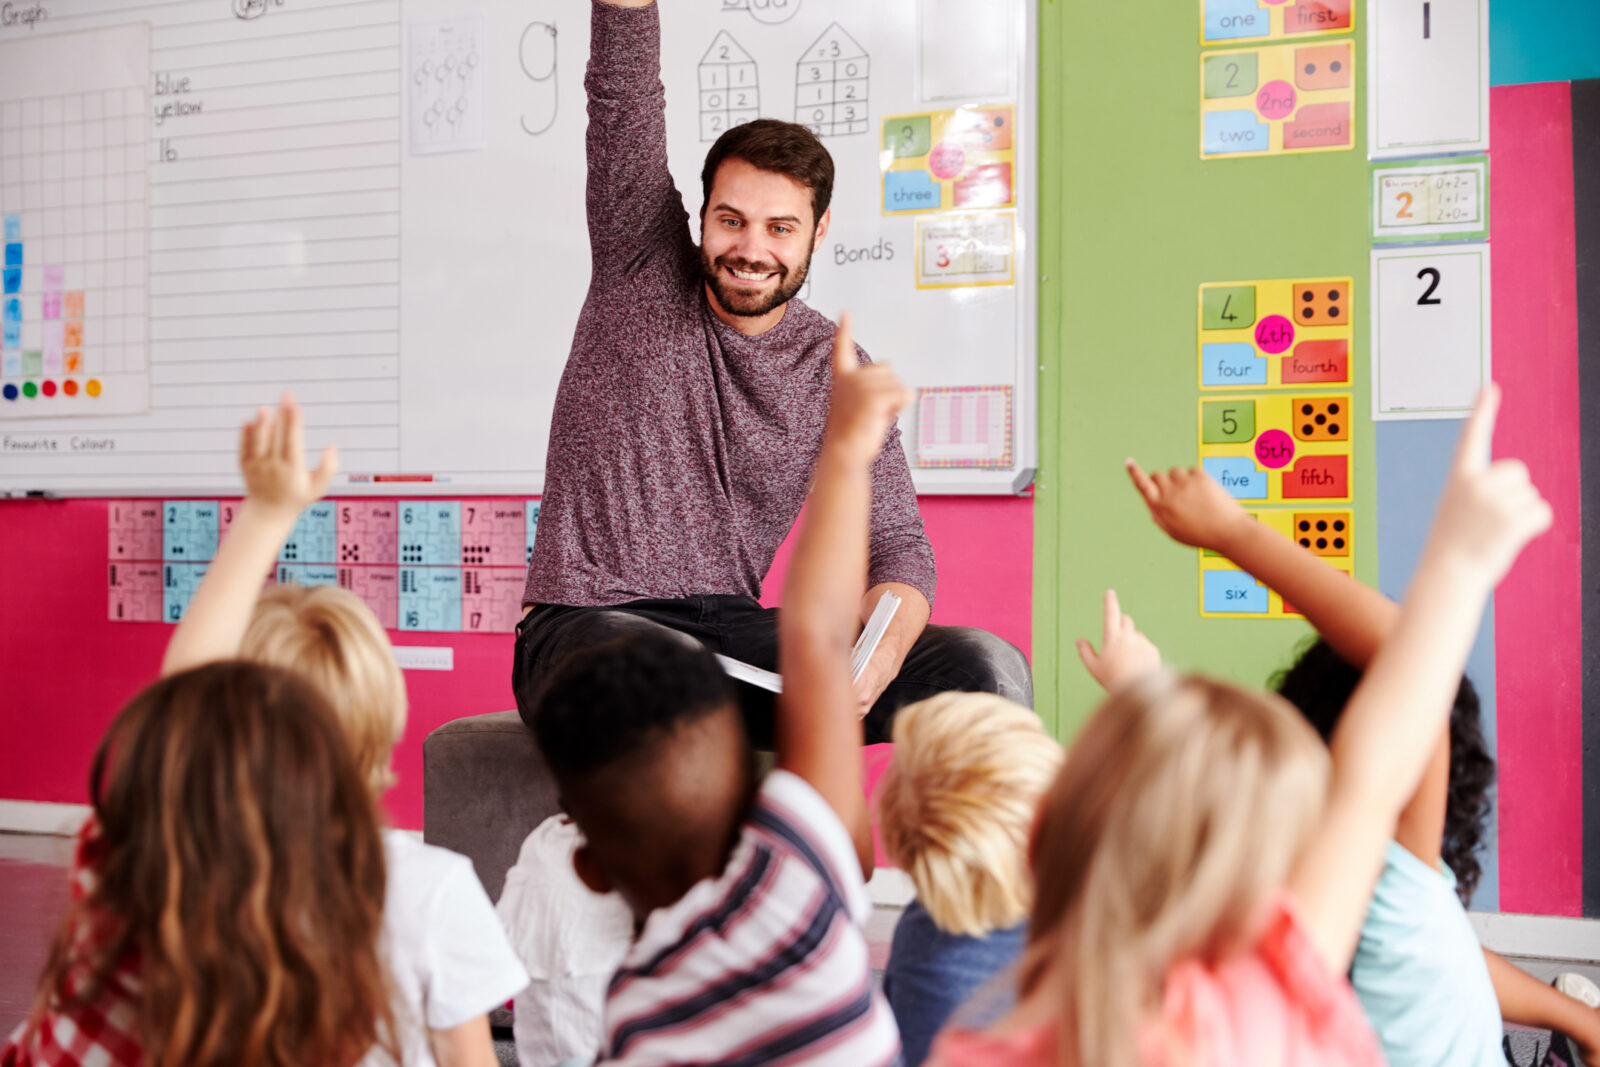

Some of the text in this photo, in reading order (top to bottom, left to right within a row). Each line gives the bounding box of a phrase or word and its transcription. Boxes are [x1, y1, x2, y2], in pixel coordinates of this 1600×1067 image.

[1, 1, 48, 27] Graph
[1219, 13, 1256, 29] one
[1296, 6, 1338, 26] first
[719, 45, 731, 61] 2
[830, 39, 842, 58] 3
[518, 20, 559, 136] g
[810, 62, 859, 81] 3 0
[1224, 62, 1240, 89] 2
[154, 71, 192, 97] blue
[845, 85, 857, 99] 2
[707, 93, 749, 109] 0 2
[1259, 91, 1294, 111] 2nd
[154, 99, 204, 126] yellow
[812, 105, 856, 123] 0 3
[710, 115, 722, 132] 2
[1292, 124, 1343, 140] second
[901, 125, 915, 151] 3
[1219, 129, 1256, 143] two
[158, 137, 179, 162] 16
[893, 187, 933, 203] three
[1395, 191, 1414, 219] 2
[833, 237, 895, 267] Bonds
[936, 244, 951, 268] 3
[1416, 266, 1442, 306] 2
[1220, 294, 1238, 323] 4
[1257, 323, 1292, 345] 4th
[1217, 359, 1252, 378] four
[1292, 358, 1339, 375] fourth
[1221, 409, 1238, 436] 5
[1258, 440, 1292, 460] 5th
[1221, 469, 1250, 487] five
[1300, 468, 1335, 486] fifth
[168, 506, 177, 524] 2
[224, 506, 233, 524] 3
[342, 507, 351, 525] 5
[404, 507, 413, 525] 6
[467, 507, 476, 525] 7
[1225, 585, 1248, 601] six
[169, 603, 182, 620] 12
[406, 610, 419, 628] 16
[470, 611, 483, 629] 17
